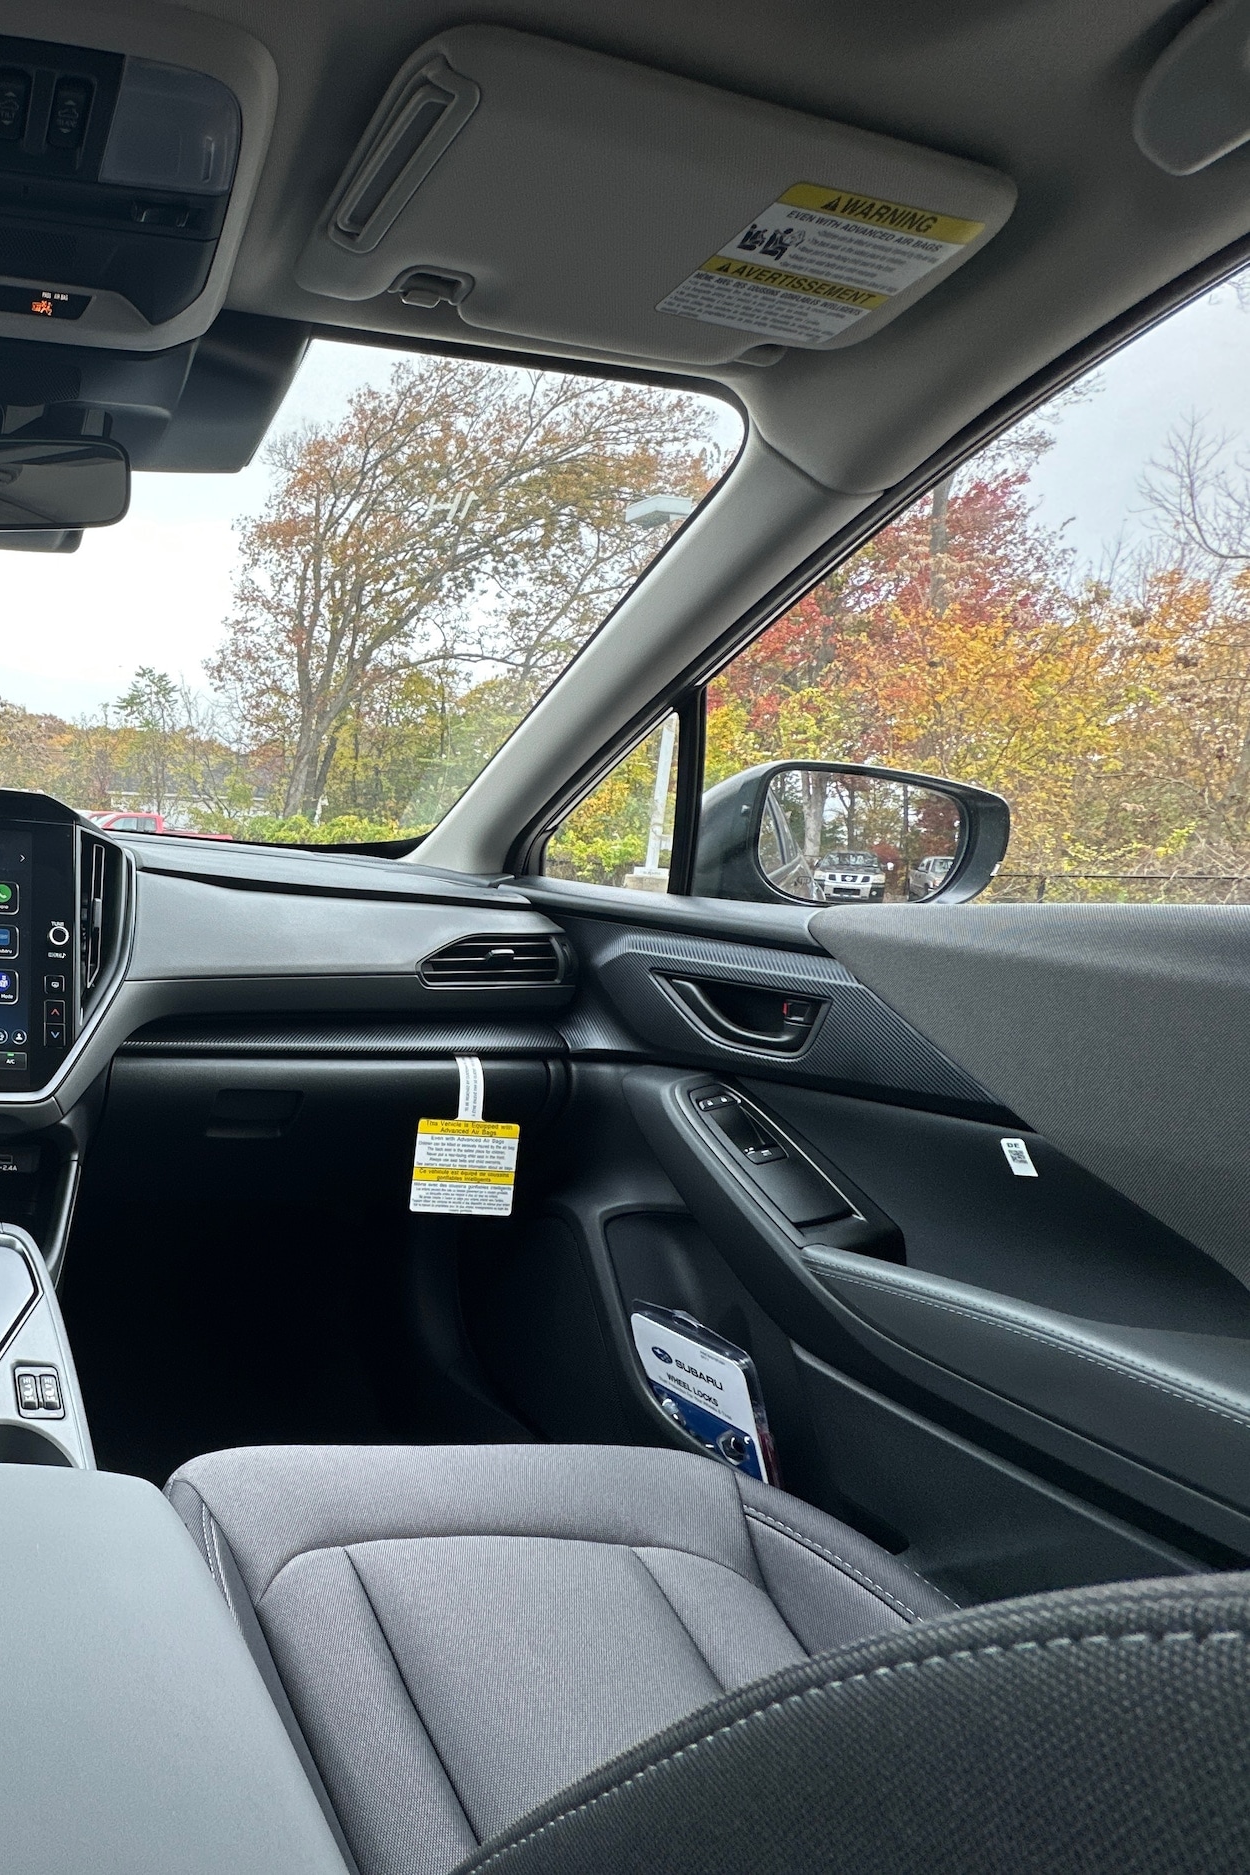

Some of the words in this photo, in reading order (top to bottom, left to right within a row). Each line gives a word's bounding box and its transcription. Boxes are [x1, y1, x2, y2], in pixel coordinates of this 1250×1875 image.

[786, 210, 816, 223] EVEN
[815, 215, 842, 230] WITH
[840, 221, 902, 242] ADVANCED
[898, 234, 915, 247] AIR
[913, 239, 943, 253] BAGS
[841, 198, 938, 233] WARNING
[732, 264, 877, 305] AVERTISSEMENT
[666, 1373, 692, 1392] WHEEL
[692, 1387, 719, 1407] LOCKS
[674, 1359, 724, 1391] SUBARU
